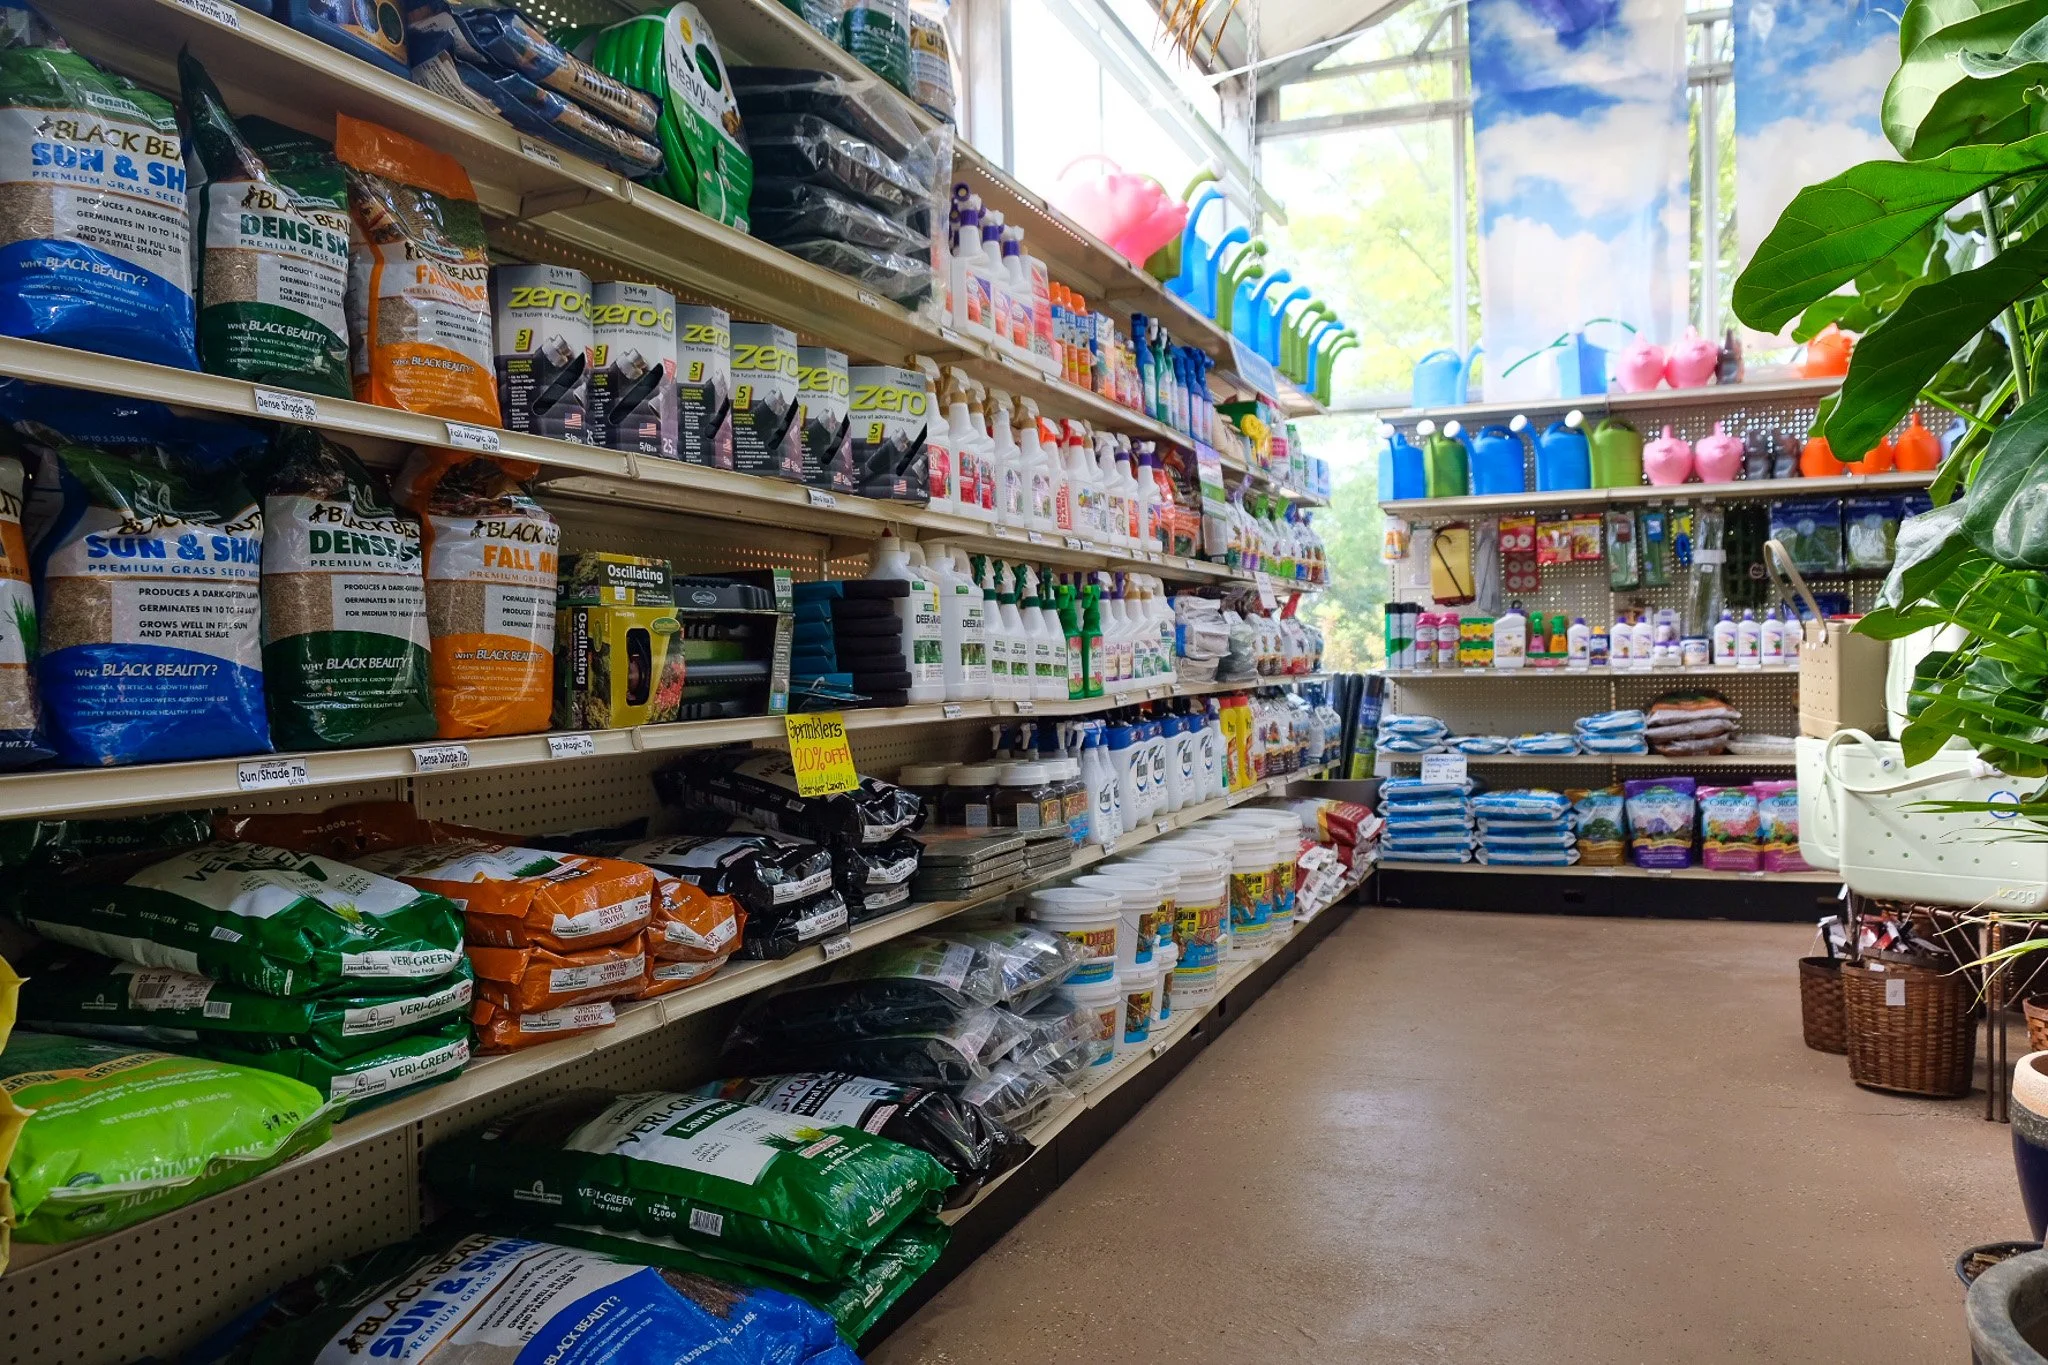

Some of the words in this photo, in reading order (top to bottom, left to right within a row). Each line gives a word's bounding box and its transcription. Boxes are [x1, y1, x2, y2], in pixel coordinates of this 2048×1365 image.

[669, 54, 706, 106] Heavy
[53, 119, 141, 153] BLACK
[32, 142, 104, 172] SUN
[113, 154, 139, 182] &
[32, 171, 100, 185] PREMIUM
[107, 181, 150, 196] GRASS
[155, 193, 183, 205] SEED
[76, 196, 124, 212] PRODUCES
[127, 205, 133, 214] A
[76, 210, 133, 228] GERMINATES
[135, 221, 146, 231] IN
[147, 225, 158, 234] 10
[159, 227, 169, 237] TO
[171, 231, 182, 240] 14
[240, 214, 323, 249] DENSE
[76, 224, 112, 239] GROWS
[114, 232, 136, 244] WELL
[138, 236, 148, 246] IN
[149, 238, 167, 251] FULL
[168, 244, 182, 256] SUN
[76, 232, 97, 242] AND
[99, 235, 134, 252] PARTIAL
[136, 243, 163, 258] SHADE
[240, 238, 296, 252] PREMIUM
[20, 260, 42, 269] WHY
[45, 257, 90, 272] BLACK
[92, 263, 148, 287] BEAUTY?
[279, 287, 292, 296] FOR
[279, 294, 305, 306] SHADED
[551, 314, 575, 322] advanced
[592, 303, 673, 333] zero-G
[227, 322, 248, 332] WHY
[248, 320, 284, 336] BLACK
[286, 327, 327, 344] BEAUTY?
[518, 330, 526, 342] 5
[682, 324, 731, 350] zero
[595, 345, 602, 357] 5
[691, 362, 698, 373] 5
[730, 344, 799, 379] zero
[738, 385, 746, 398] 5
[797, 366, 849, 398] zero
[258, 396, 280, 411] Dense
[281, 400, 303, 414] Shade
[851, 384, 927, 416] zero
[871, 422, 878, 434] 5
[487, 521, 543, 544] BLACK
[85, 534, 167, 559] SUN
[177, 533, 205, 561] &
[311, 559, 372, 568] PREMIUM
[483, 545, 535, 571] FALL
[88, 564, 164, 574] PREMIUM
[172, 565, 216, 576] GRASS
[221, 567, 245, 577] SEED
[469, 571, 519, 580] PREMIUM
[608, 564, 664, 584] Oscillating
[139, 588, 190, 598] PRODUCES
[193, 588, 200, 598] A
[139, 604, 200, 614] GERMINATES
[202, 604, 212, 614] IN
[215, 605, 225, 614] 10
[226, 605, 235, 614] TO
[139, 620, 178, 630] GROWS
[180, 620, 203, 630] WELL
[205, 621, 216, 630] IN
[233, 621, 248, 630] SUN
[139, 629, 162, 638] AND
[165, 629, 202, 639] PARTIAL
[204, 630, 229, 639] SHADE
[476, 649, 509, 661] BLACK
[578, 612, 588, 685] Oscillating
[74, 668, 99, 678] WHY
[101, 663, 152, 678] BLACK
[155, 663, 218, 678] BEAUTY?
[301, 662, 323, 672] WHY
[326, 657, 367, 670] BLACK
[789, 717, 842, 743] Sprinklers
[419, 754, 439, 766] Dense
[439, 752, 458, 763] Shade
[795, 746, 826, 772] 20%
[825, 743, 849, 765] OFF!
[240, 767, 289, 783] Sun/Shade
[291, 766, 305, 777] 7lb
[1710, 799, 1753, 807] ORGANIC
[391, 951, 452, 967] VERI-GREEN
[346, 965, 372, 973] Jonathan
[400, 991, 456, 1017] VERI-GREEN
[347, 1021, 376, 1030] Jonathan
[377, 1018, 394, 1027] Green
[389, 1051, 454, 1079] VERI-GREEN
[7, 1073, 57, 1092] GROW
[367, 1082, 385, 1092] Green
[677, 1113, 709, 1132] Lawn
[358, 1275, 438, 1337] BLACK
[402, 1305, 459, 1359] PREMIUM
[461, 1270, 496, 1302] GRASS
[492, 1288, 529, 1328] GERMINATES
[369, 1300, 447, 1359] SUN
[432, 1276, 475, 1295] &
[507, 1309, 532, 1329] GROWS
[517, 1317, 532, 1331] AND
[544, 1332, 579, 1365] BLACK
[575, 1295, 622, 1337] BEAUTY?
[730, 1323, 744, 1337] 25
